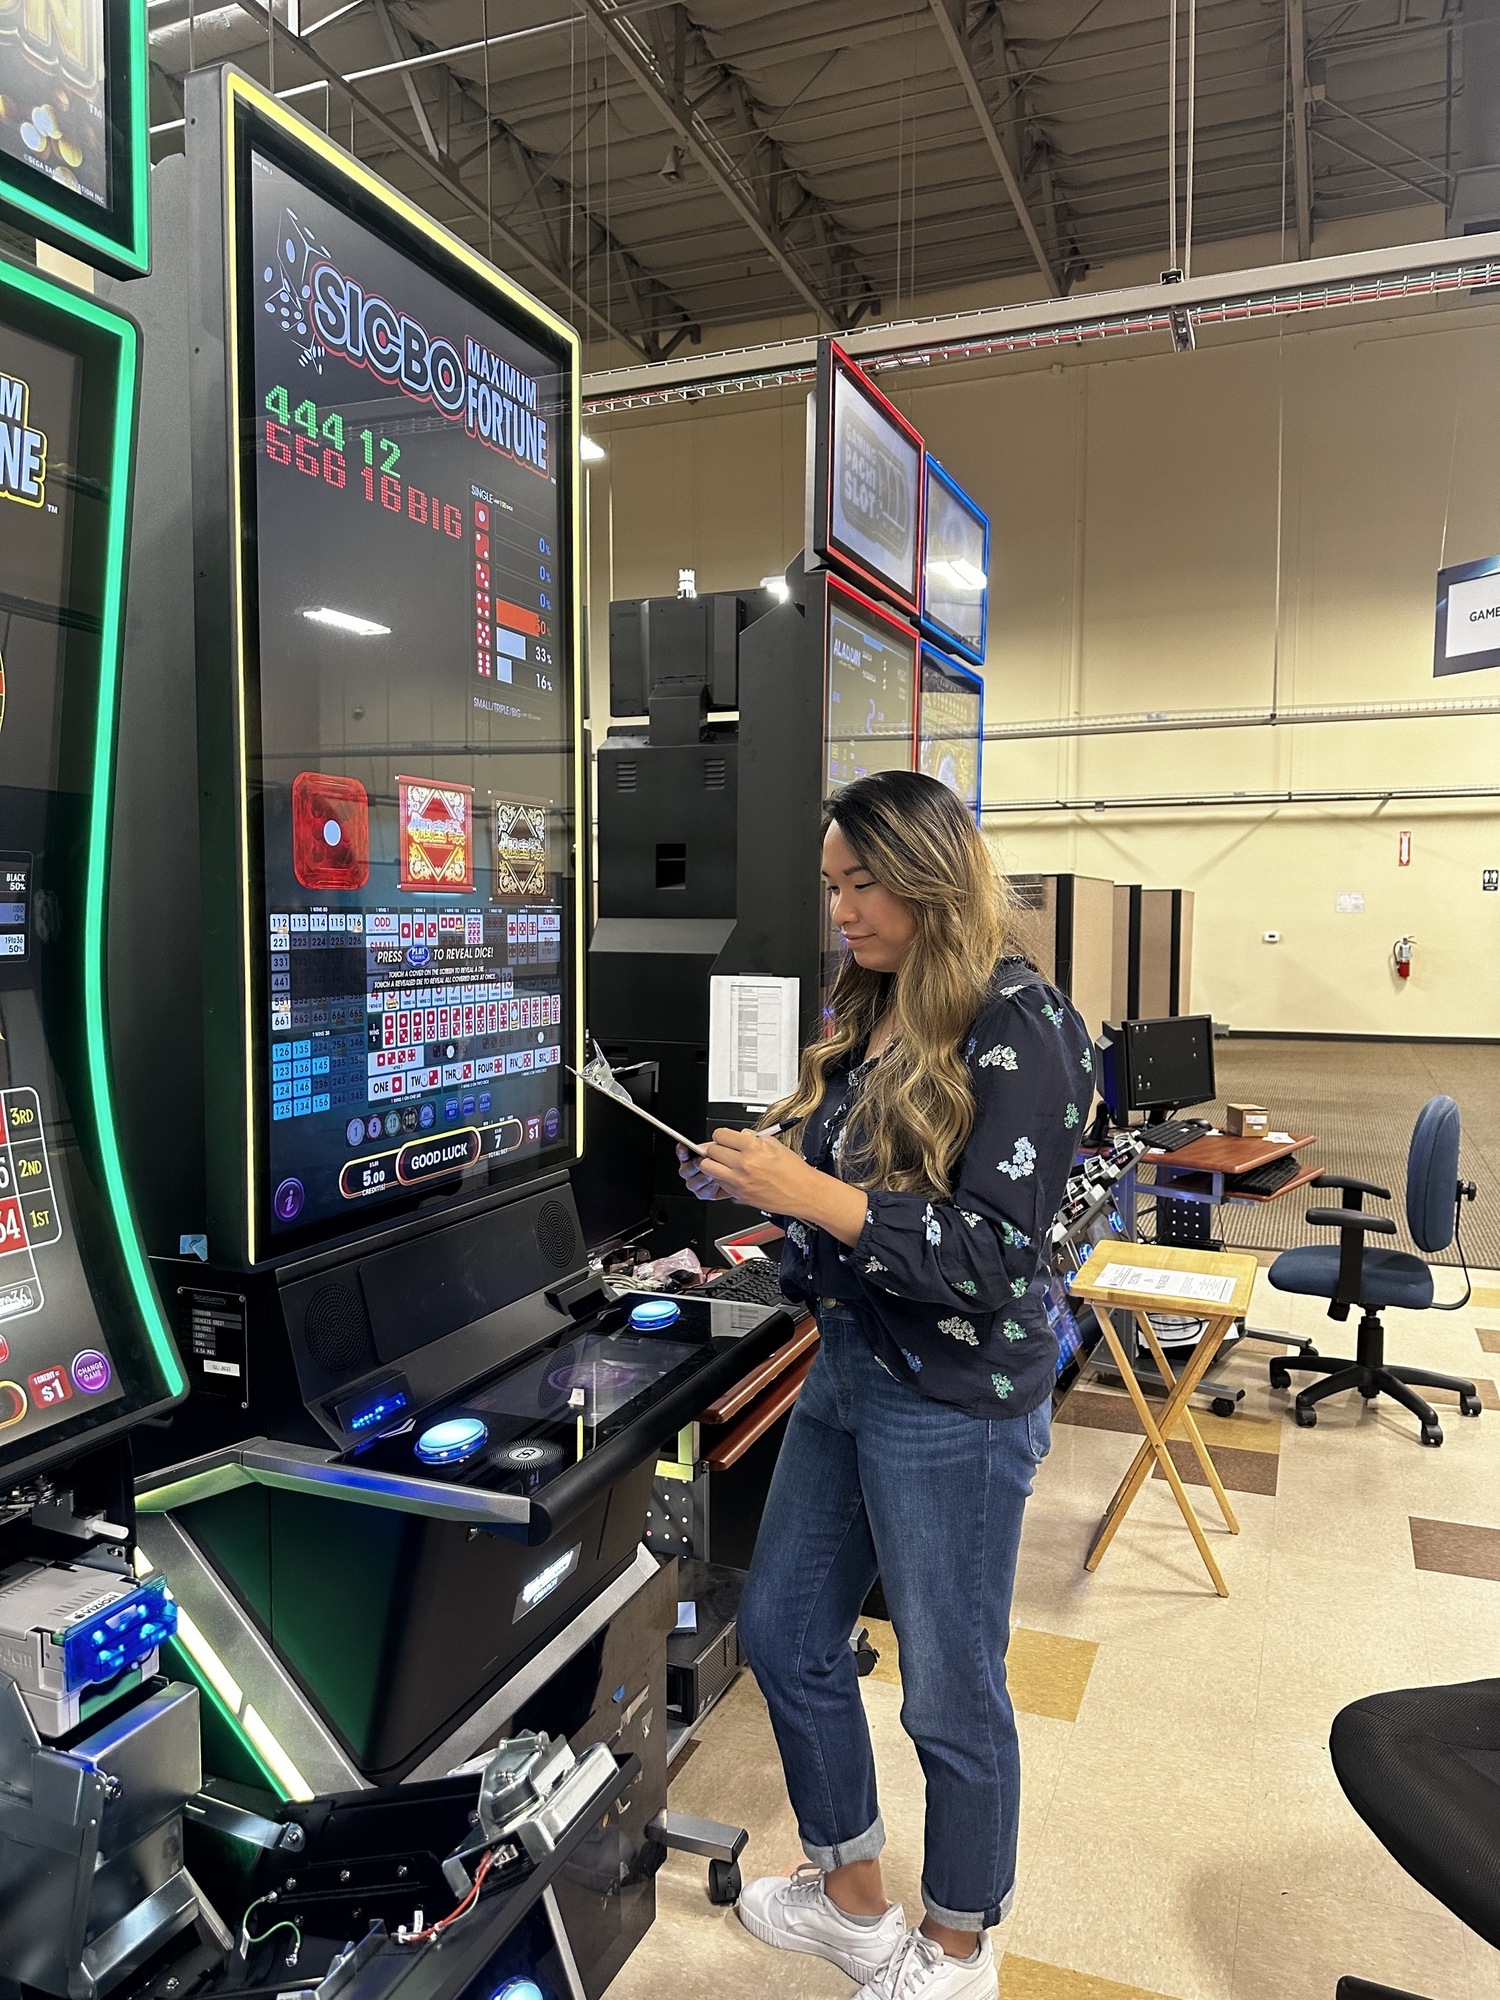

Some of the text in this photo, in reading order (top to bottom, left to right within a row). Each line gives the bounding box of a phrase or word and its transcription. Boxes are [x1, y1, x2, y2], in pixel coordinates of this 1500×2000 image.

[314, 265, 465, 410] SICBO
[467, 338, 537, 411] MAXIMUM
[467, 374, 547, 470] FORTUNE
[265, 385, 401, 478] 444 12
[845, 423, 877, 465] GAMING
[266, 420, 462, 539] 556 16 BIG
[471, 484, 494, 505] SINGLE
[844, 470, 876, 519] SLOT
[47, 504, 59, 515] TM
[539, 537, 551, 556] 0%
[539, 565, 551, 583] 0%
[539, 593, 552, 611] 0%
[535, 646, 552, 665] 33%
[833, 638, 861, 667] ALADDIN
[536, 673, 553, 692] 16%
[6, 873, 26, 882] BLACK
[9, 882, 26, 891] 50%
[12, 905, 24, 913] ODD
[14, 914, 24, 922] 0%
[272, 918, 288, 927] 112
[292, 918, 307, 927] 113
[311, 918, 326, 927] 114
[330, 918, 344, 927] 115
[348, 917, 362, 927] 116
[374, 917, 391, 928] ODD
[542, 916, 556, 926] EVEN
[273, 938, 288, 948] 221
[292, 937, 307, 947] 223
[312, 937, 326, 946] 224
[330, 937, 344, 946] 225
[8, 945, 24, 953] 50%
[377, 950, 403, 964] PRESS
[433, 948, 445, 960] TO
[446, 947, 473, 960] REVEAL
[474, 946, 494, 959] DICE!
[273, 957, 288, 967] 331
[388, 970, 405, 979] TOUCH
[274, 976, 289, 987] 441
[374, 980, 391, 989] TOUCH
[274, 995, 289, 1006] 551
[274, 1015, 289, 1026] 661
[293, 1014, 309, 1024] 662
[313, 1012, 328, 1022] 663
[274, 1047, 290, 1058] 126
[294, 1044, 309, 1055] 135
[295, 1063, 310, 1074] 136
[314, 1060, 328, 1071] 145
[477, 1062, 494, 1074] FOUR
[274, 1066, 290, 1077] 123
[445, 1067, 462, 1081] THR
[411, 1073, 428, 1088] TW
[274, 1086, 290, 1097] 124
[295, 1082, 310, 1093] 146
[373, 1080, 389, 1094] ONE
[295, 1100, 310, 1112] 134
[314, 1097, 329, 1108] 156
[275, 1104, 291, 1116] 125
[10, 1107, 35, 1126] 3RD
[372, 1121, 377, 1133] 5
[389, 1117, 397, 1129] 10
[354, 1126, 358, 1137] 1
[528, 1124, 540, 1140] $1
[494, 1134, 502, 1149] 7
[411, 1142, 468, 1170] GOOD LUCK
[488, 1149, 500, 1159] TOTAL
[18, 1159, 43, 1179] 2ND
[362, 1169, 386, 1187] 5.00
[29, 1209, 50, 1228] 1ST
[77, 1361, 104, 1376] CHANGE
[83, 1370, 102, 1382] GAME
[41, 1378, 65, 1403] $1
